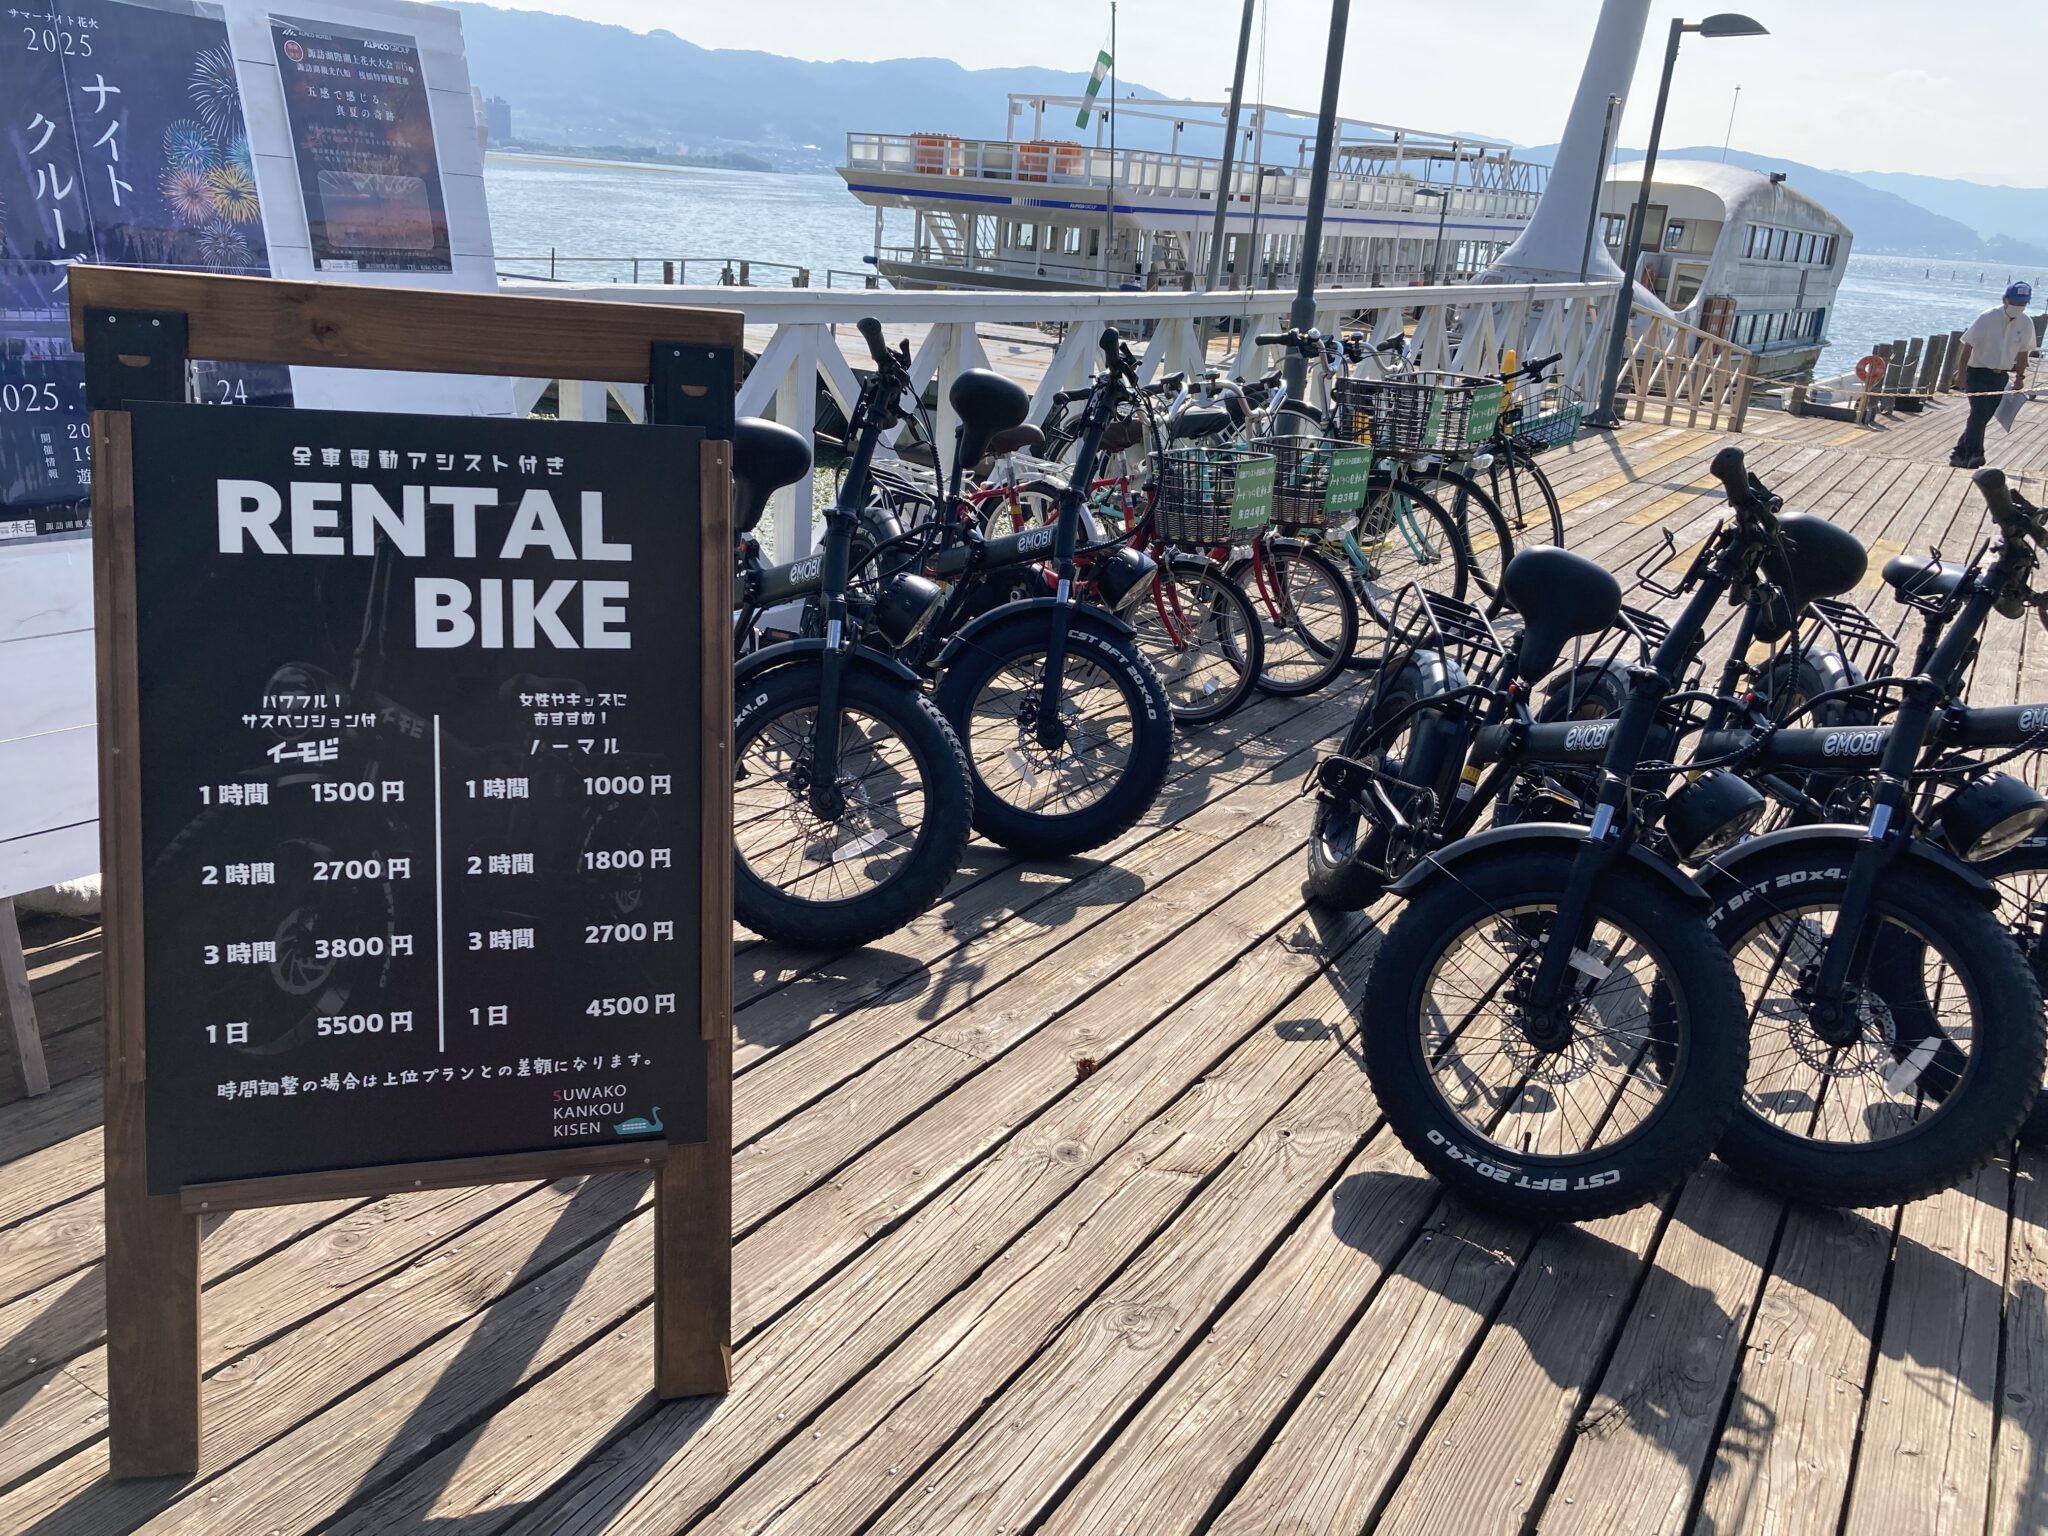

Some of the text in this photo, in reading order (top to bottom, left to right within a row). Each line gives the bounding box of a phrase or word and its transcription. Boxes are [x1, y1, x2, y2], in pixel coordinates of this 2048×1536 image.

[8, 8, 99, 29] サマーナイト花火
[23, 27, 92, 57] 2025
[363, 41, 389, 51] ALPICO
[80, 73, 134, 207] ナイト
[0, 382, 87, 413] 025.
[292, 446, 564, 476] 全車電動アシスト付き
[11, 521, 36, 535] 朱白
[217, 479, 632, 562] RENTAL
[1017, 529, 1052, 553] eMOBI
[789, 556, 822, 585] eMOBI
[414, 577, 632, 650] BIKE
[1067, 629, 1099, 644] CST
[1098, 640, 1129, 663] BFT
[263, 694, 341, 709] パワフル！
[519, 692, 628, 708] 女性やキッズに
[241, 712, 377, 729] サスペンション付
[533, 711, 607, 726] おすすめ！
[530, 738, 620, 756] ノーマル
[1564, 723, 1613, 751] eMOBI
[1823, 730, 1885, 758] eMOBI
[1706, 906, 1726, 931] ST
[217, 1052, 652, 1101] 時間調整の場合は上位プランとの差額になります。
[553, 1084, 627, 1102] SUWAKO
[553, 1102, 624, 1120] KANKOU
[553, 1121, 601, 1137] KISEN
[1514, 1175, 1567, 1192] BFT
[1573, 1169, 1622, 1192] CST
